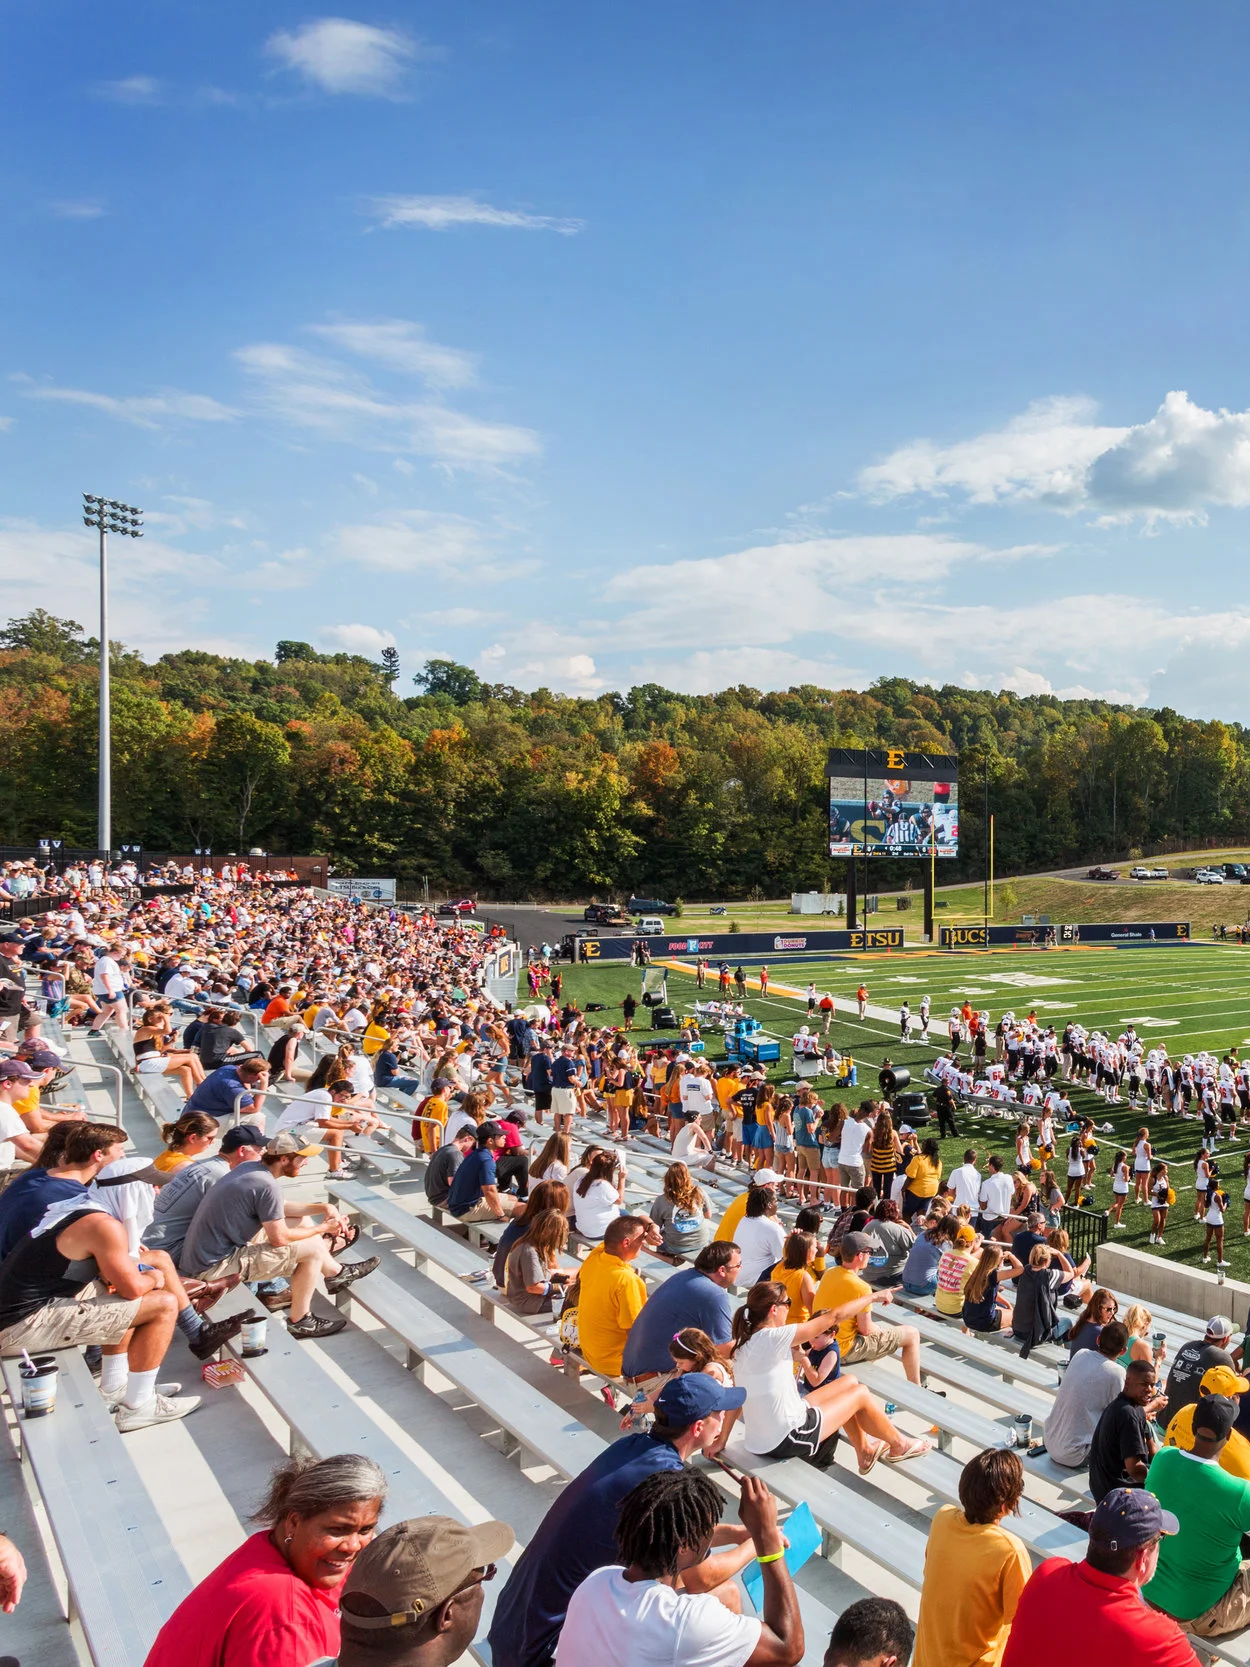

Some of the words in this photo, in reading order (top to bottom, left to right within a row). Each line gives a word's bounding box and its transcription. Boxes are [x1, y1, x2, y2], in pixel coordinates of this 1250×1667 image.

[887, 750, 905, 769] E
[850, 932, 900, 947] ETSU
[945, 929, 990, 944] BUCS
[668, 942, 688, 951] FOOD
[698, 941, 714, 949] CITY
